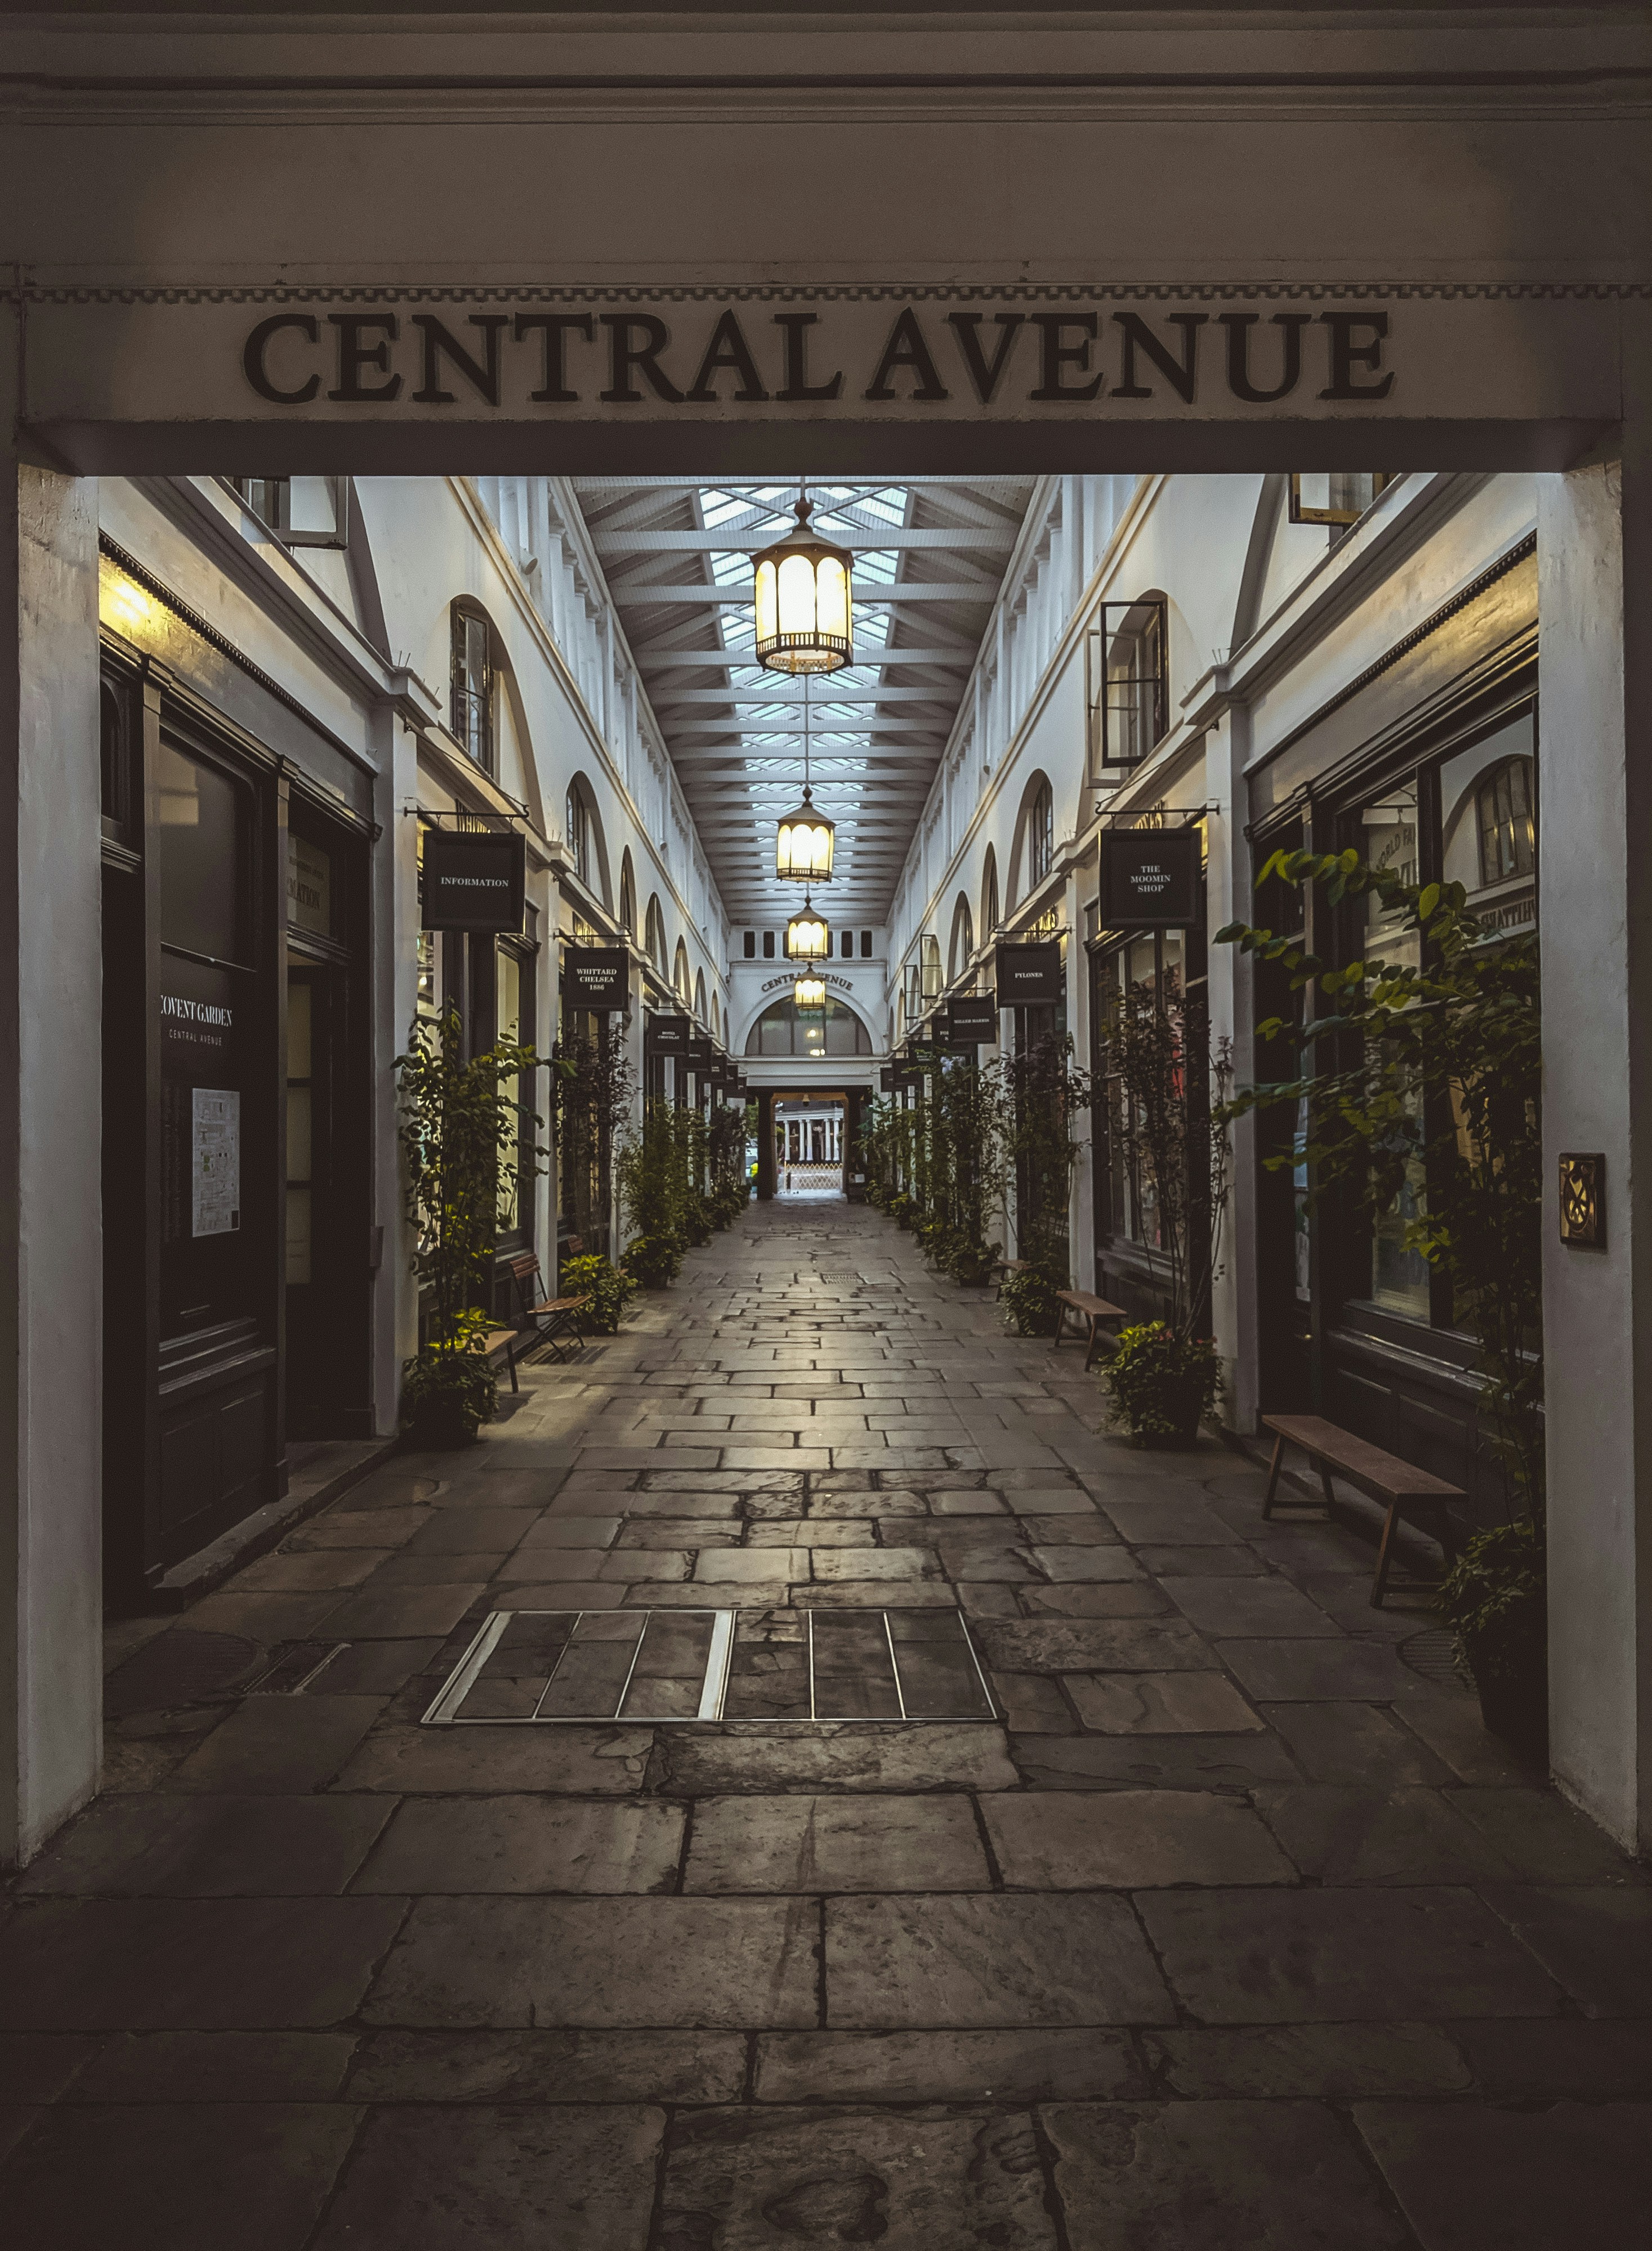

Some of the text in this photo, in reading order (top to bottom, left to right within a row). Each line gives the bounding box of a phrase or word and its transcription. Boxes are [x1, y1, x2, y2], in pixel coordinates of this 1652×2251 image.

[243, 306, 1395, 407] CENTRAL AVENUE
[441, 877, 508, 886] INFORMATION
[761, 973, 853, 992] CENTR ENUE
[197, 1004, 232, 1027] GARDEN
[169, 1029, 222, 1046] CENTRAL AVENUE
